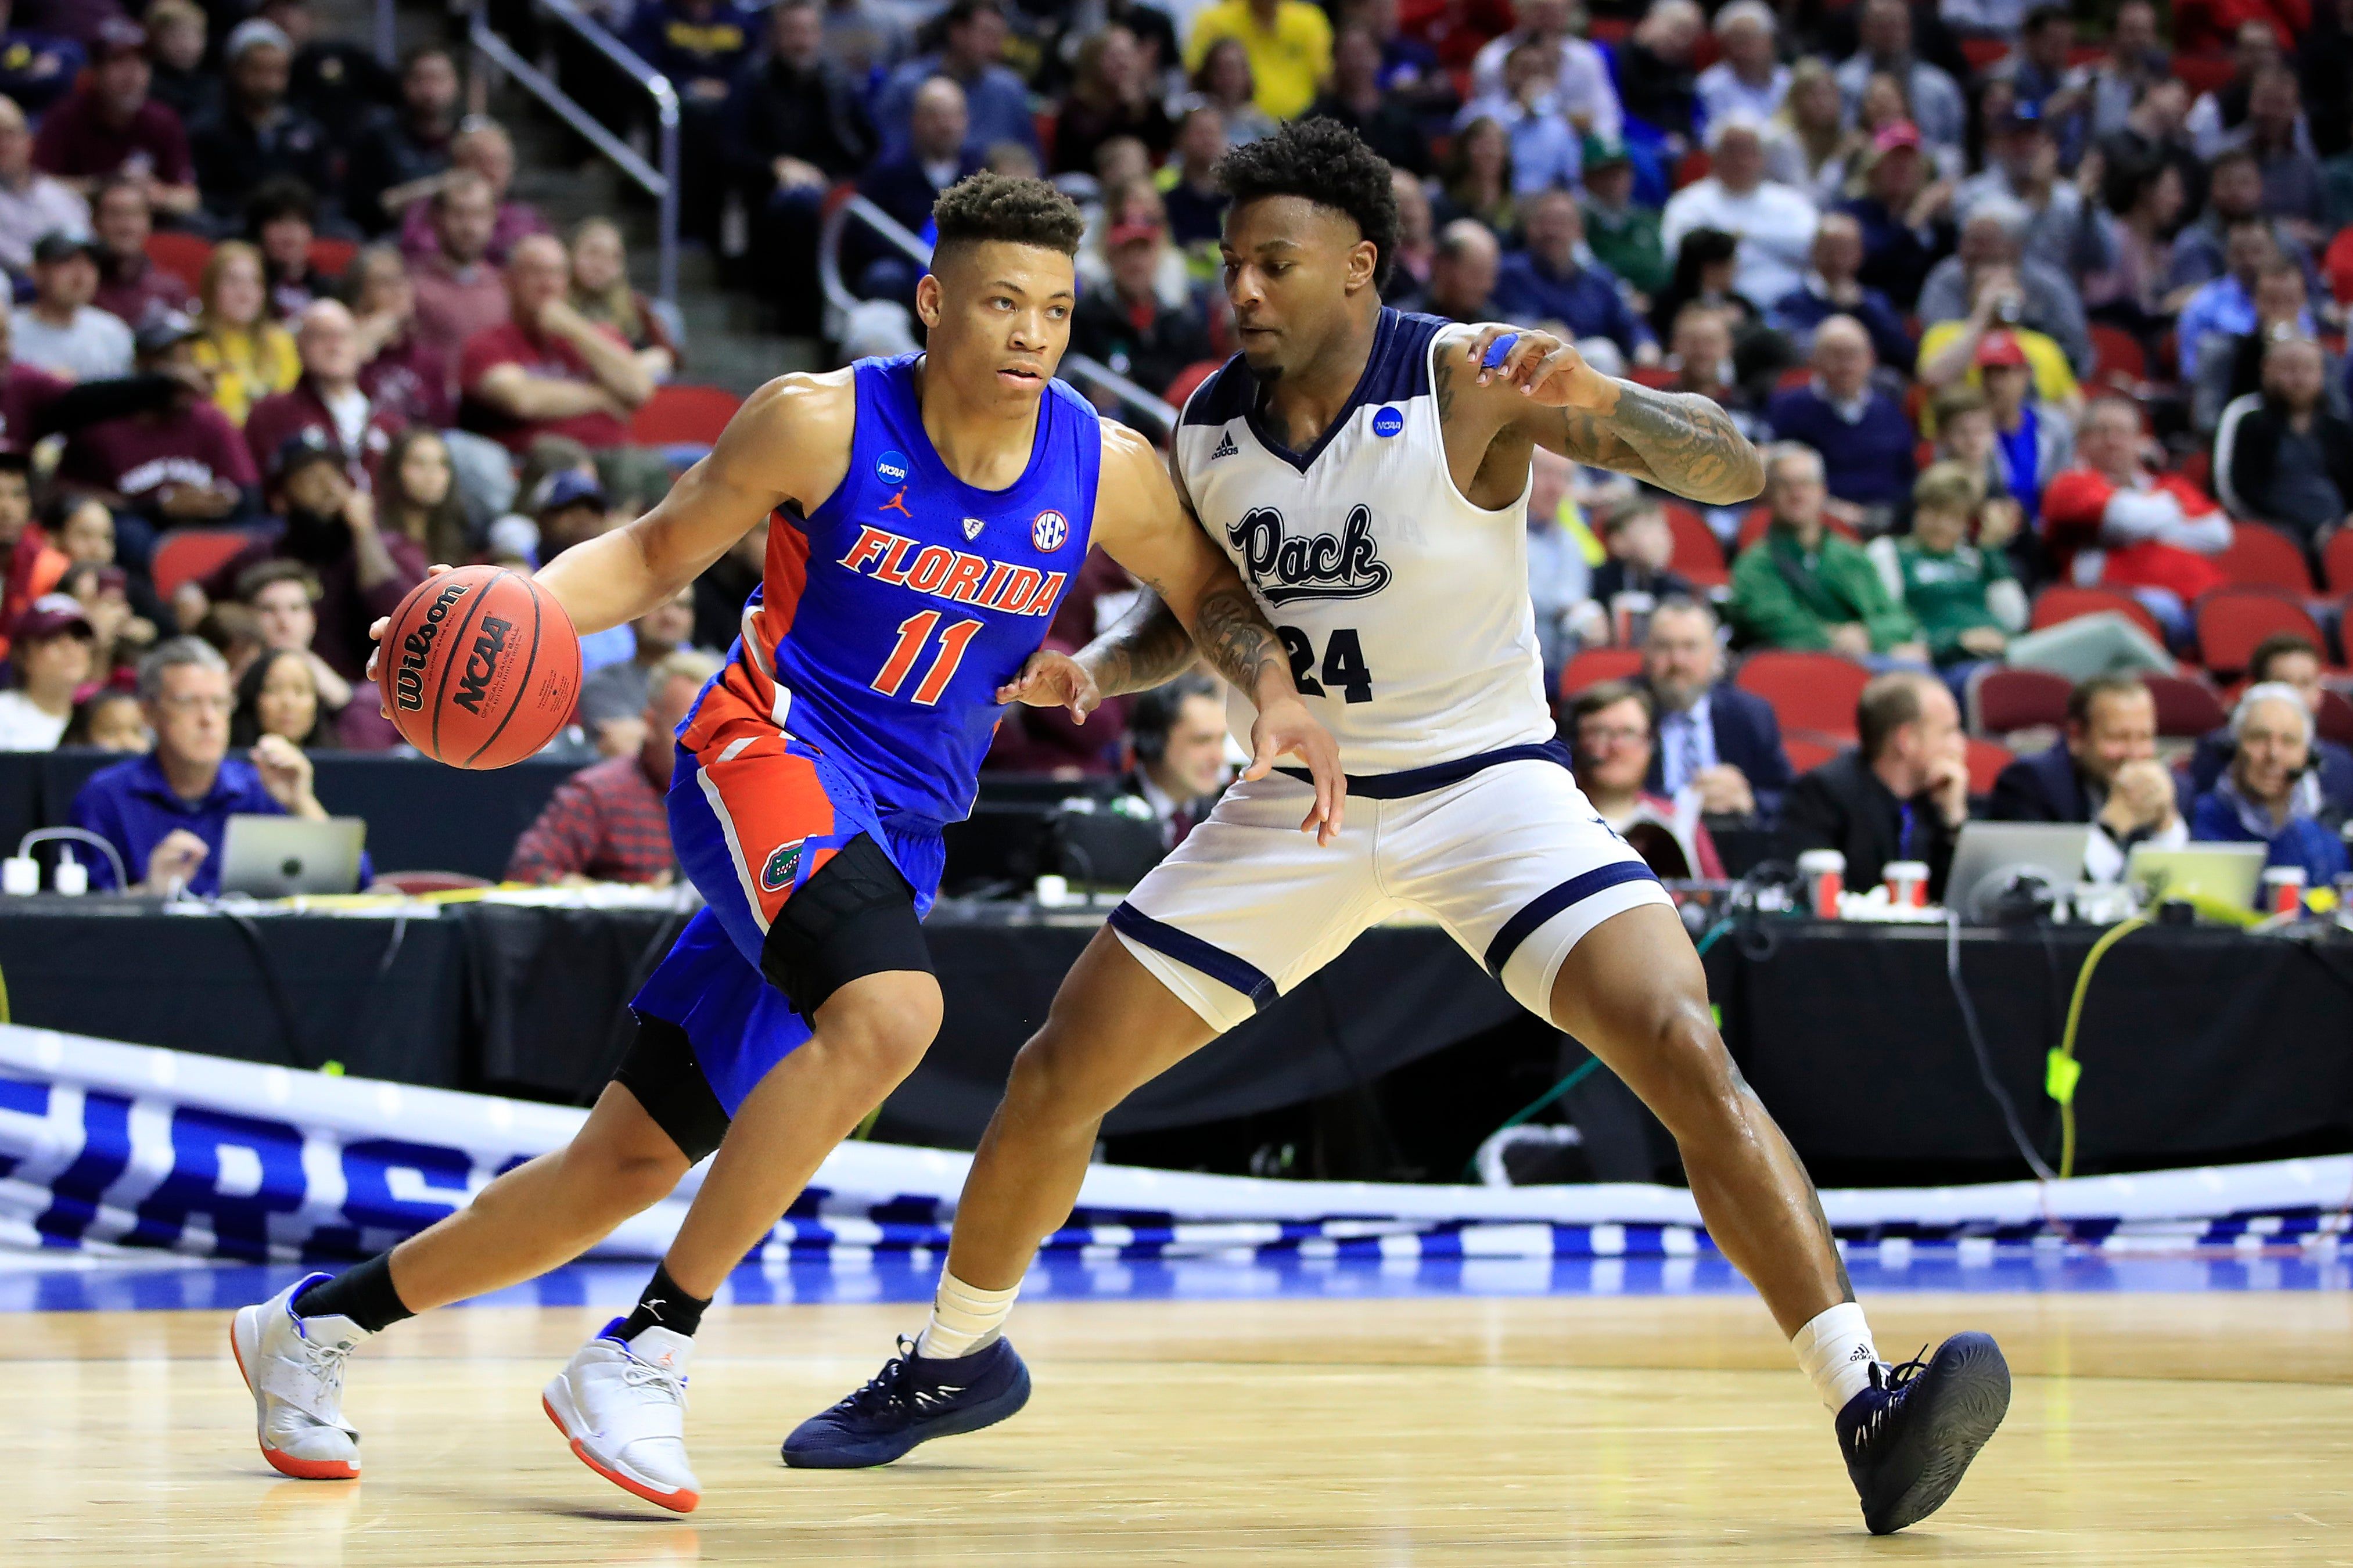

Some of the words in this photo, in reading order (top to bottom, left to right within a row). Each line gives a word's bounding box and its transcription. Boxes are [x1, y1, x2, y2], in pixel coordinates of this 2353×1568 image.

[1212, 447, 1238, 460] adidas
[1377, 421, 1401, 430] NCAA
[878, 463, 906, 479] NCAA
[836, 524, 1068, 616] FLORIDA
[1034, 513, 1066, 549] SEC
[1226, 504, 1392, 608] Pack
[397, 584, 470, 711] Wilson
[453, 616, 512, 715] NCAA
[870, 609, 984, 707] 11
[1276, 625, 1373, 704] 24
